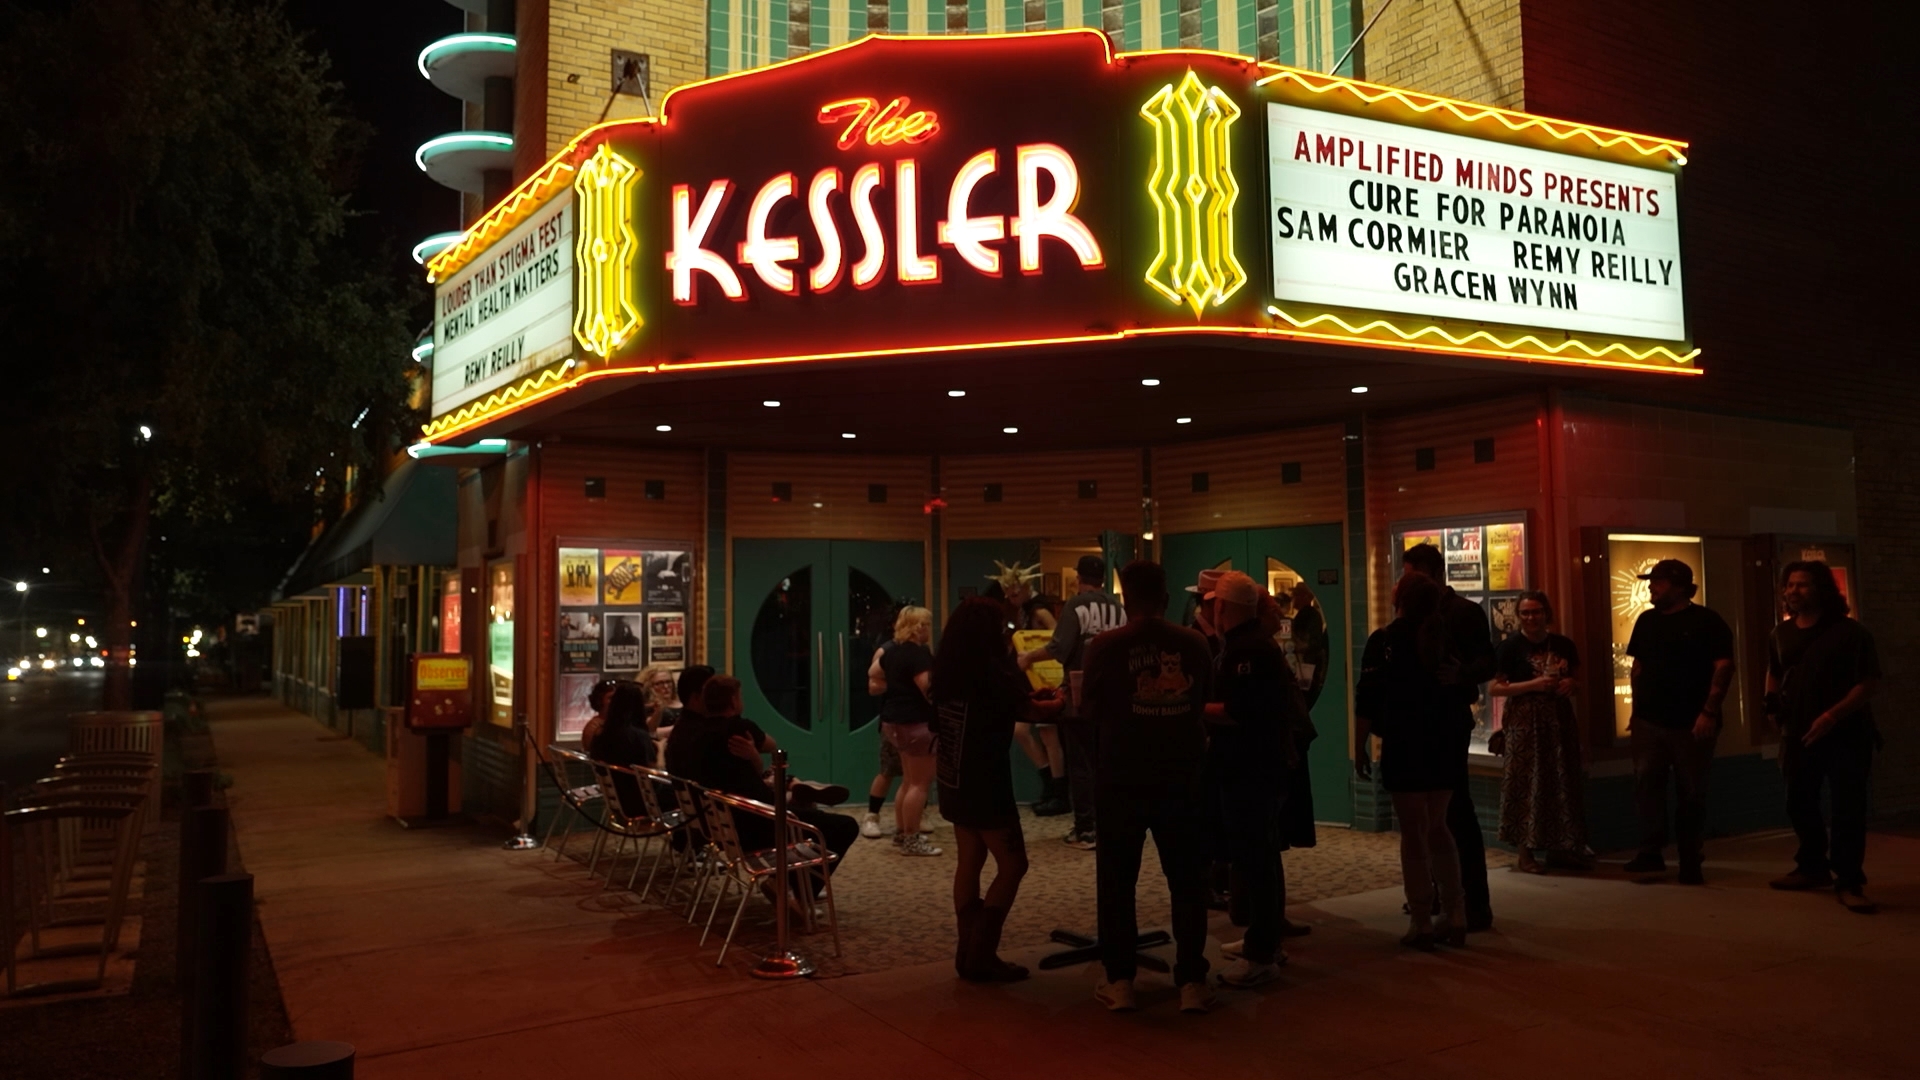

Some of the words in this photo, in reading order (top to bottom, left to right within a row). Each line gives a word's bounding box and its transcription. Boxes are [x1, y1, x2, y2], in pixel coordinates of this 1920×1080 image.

[817, 96, 940, 151] The
[1294, 131, 1443, 183] AMPLIFIED
[1456, 158, 1533, 198] MINDS
[1545, 172, 1660, 217] PRESENTS
[665, 142, 1105, 306] KESSLER
[1277, 206, 1338, 244] SAM
[1348, 217, 1470, 262] CORMIER
[1513, 240, 1580, 275] REMY
[1591, 250, 1674, 286] REILLY
[1349, 179, 1419, 219] CURE
[1437, 192, 1486, 227] FOR
[1500, 202, 1626, 247] PARANOIA
[442, 280, 472, 318] LOUDER
[475, 260, 497, 297] THAN
[500, 233, 536, 280] STIGMA
[538, 211, 563, 253] FEST
[444, 306, 475, 344] MENTAL
[478, 281, 511, 325] HEALTH
[514, 249, 559, 303] MATTERS
[1394, 262, 1497, 303] GRACEN
[1508, 275, 1578, 311] WYNN
[464, 354, 488, 389] REMY
[491, 335, 525, 377] REILLY
[420, 663, 467, 679] Observer
[1132, 703, 1160, 717] TOMMY
